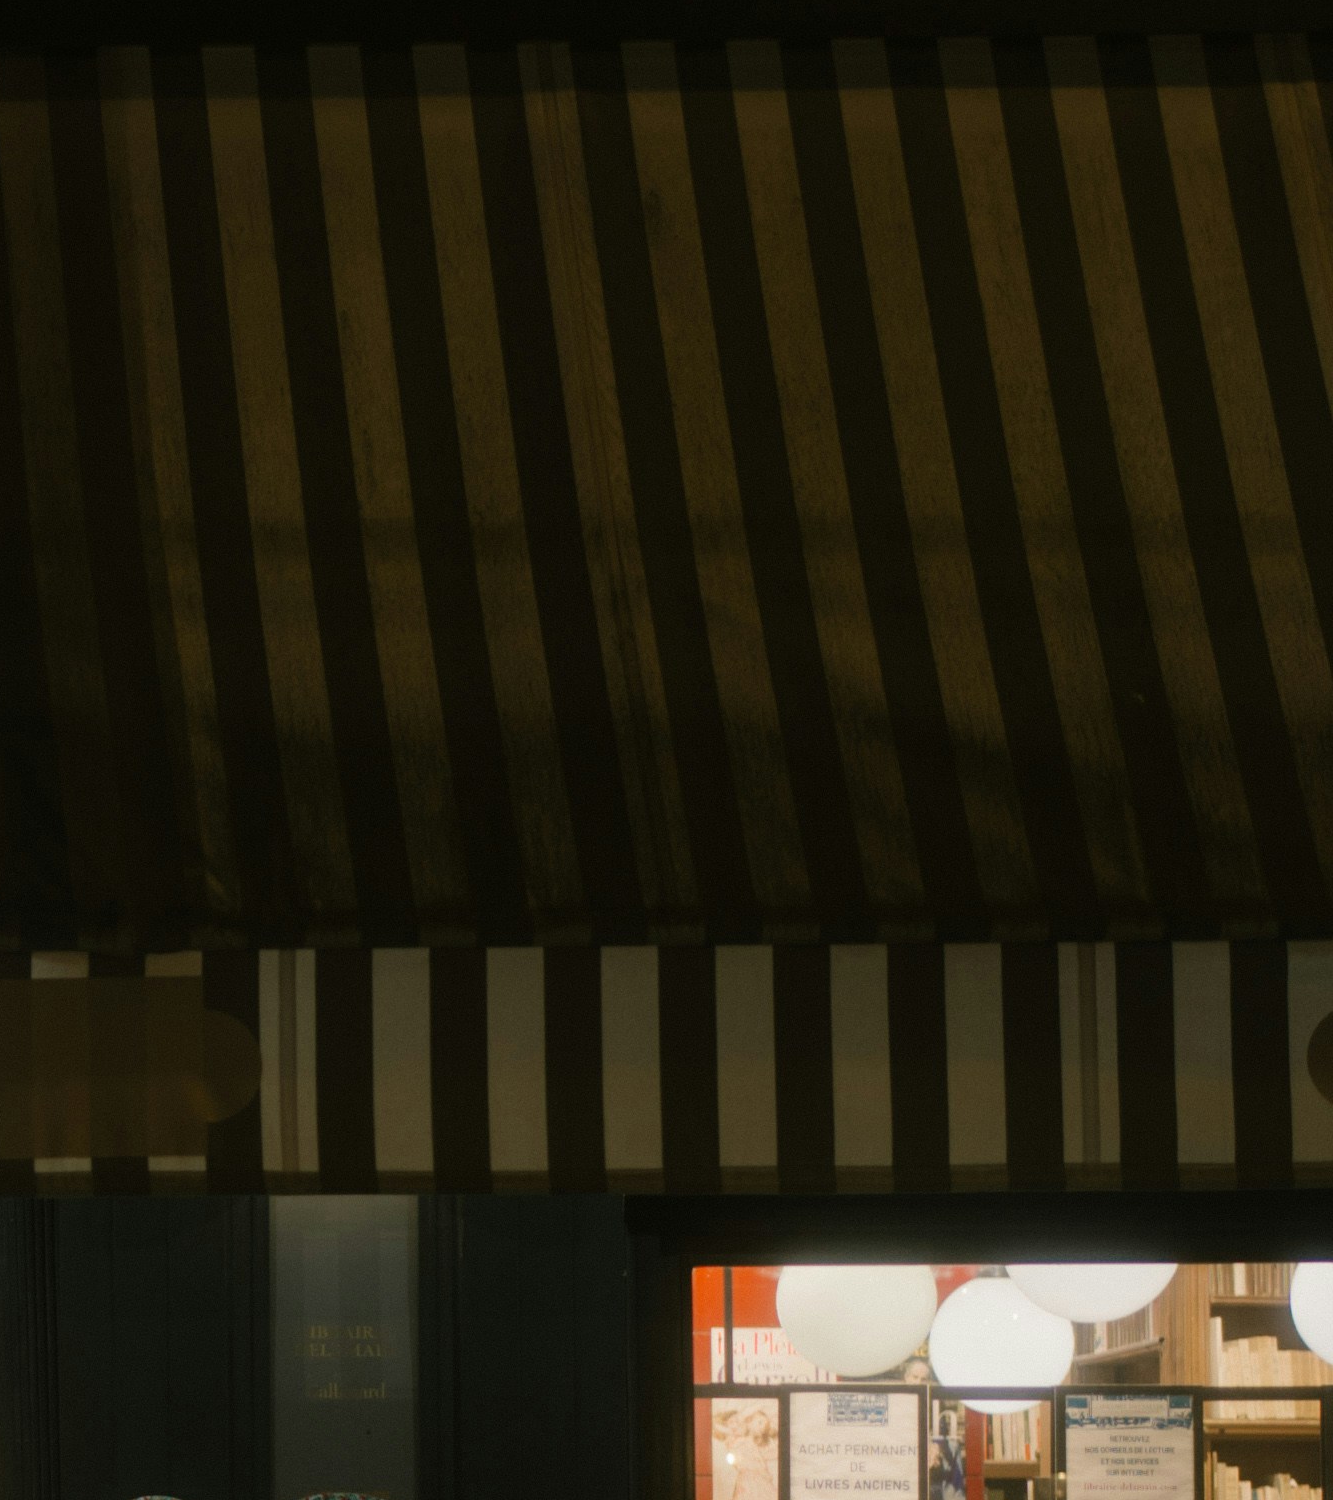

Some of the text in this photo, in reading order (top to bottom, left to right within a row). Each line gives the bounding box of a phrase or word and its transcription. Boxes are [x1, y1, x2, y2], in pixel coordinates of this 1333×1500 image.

[798, 1444, 918, 1457] ACHAT PERMANEN
[850, 1461, 866, 1473] DE
[805, 1479, 911, 1491] LIVRES ANCIENS
